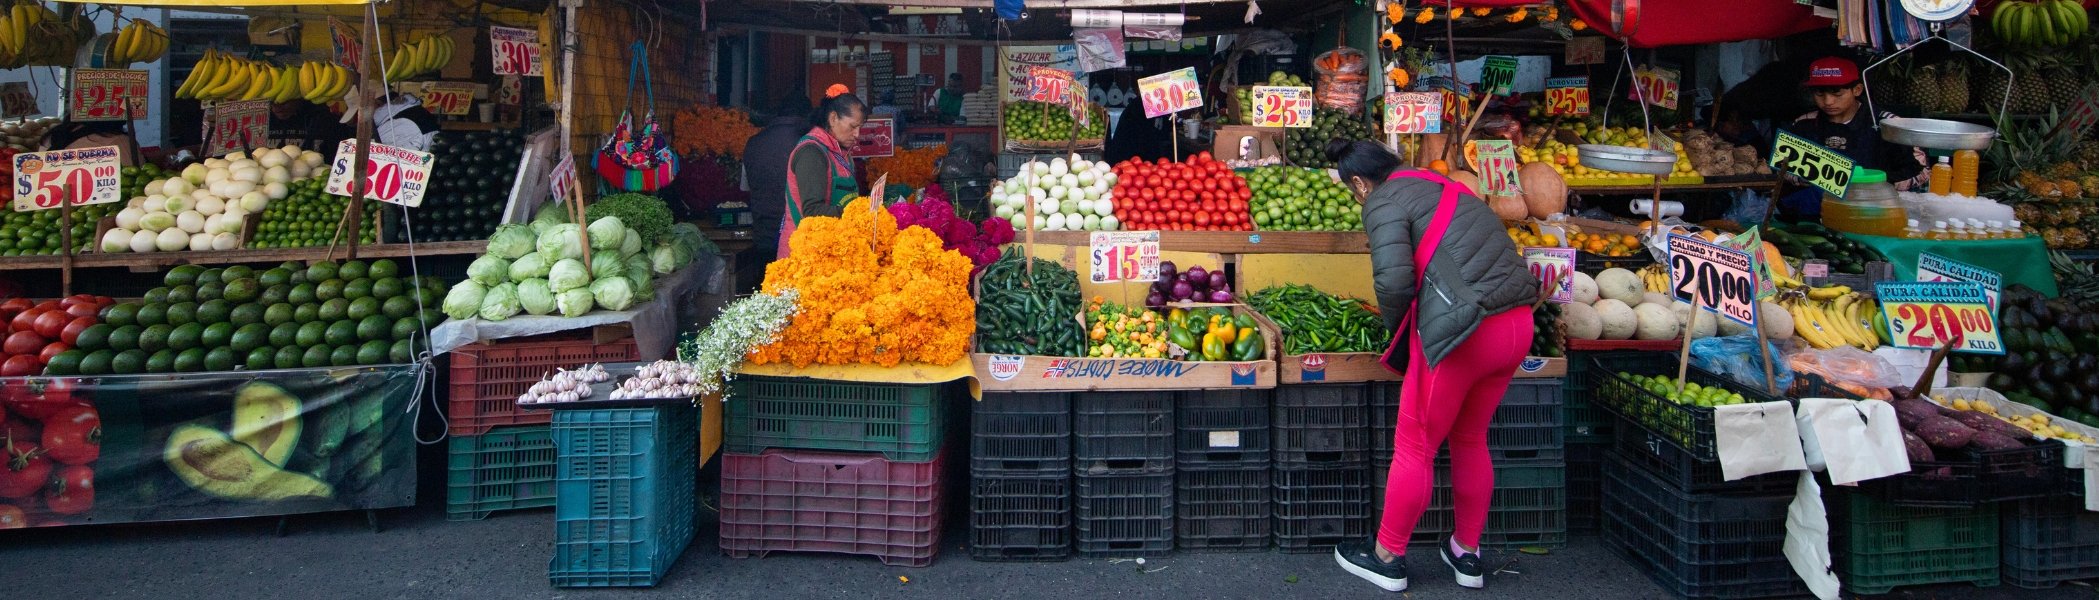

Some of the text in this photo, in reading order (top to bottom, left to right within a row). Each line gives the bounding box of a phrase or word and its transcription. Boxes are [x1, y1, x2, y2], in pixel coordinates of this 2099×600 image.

[502, 41, 530, 74] 30
[529, 47, 539, 55] 00
[1016, 52, 1051, 62] AZUCAR
[1500, 70, 1513, 85] 00
[75, 88, 84, 110] $
[87, 85, 126, 116] 25
[428, 92, 457, 112] 20
[503, 86, 511, 98] $
[1034, 78, 1060, 104] 20
[1154, 84, 1184, 111] 30
[1184, 80, 1195, 90] 00
[1549, 88, 1588, 113] $ 25 00
[1257, 105, 1263, 116] $
[1266, 95, 1297, 125] 25
[1395, 104, 1426, 132] 25
[1427, 105, 1438, 113] 00
[226, 116, 252, 148] 25
[62, 151, 75, 160] SE
[78, 148, 117, 160] DUERMA
[1780, 134, 1812, 150] CALIDAD
[1821, 151, 1850, 167] PRECIO
[334, 157, 347, 176] $
[405, 169, 423, 181] 00
[1484, 158, 1506, 192] 15
[1774, 145, 1821, 181] 25
[1822, 164, 1848, 186] 00
[18, 166, 115, 207] $ 50 00
[96, 178, 116, 187] KILO
[403, 182, 421, 190] KILO
[1818, 180, 1841, 196] KILO
[1094, 245, 1156, 280] $ 15 00
[1671, 240, 1705, 255] CALIDAD
[1716, 252, 1746, 267] PRECIO
[1672, 255, 1751, 309] $ 20 00
[1923, 257, 1946, 271] PURA
[1950, 267, 1998, 286] CALIDAD
[1884, 288, 1980, 298] PURA CALIDAD
[1725, 303, 1752, 321] KILO
[1892, 303, 1992, 349] $ 20 00
[1968, 340, 1996, 350] KILO
[992, 364, 1018, 373] NORGE
